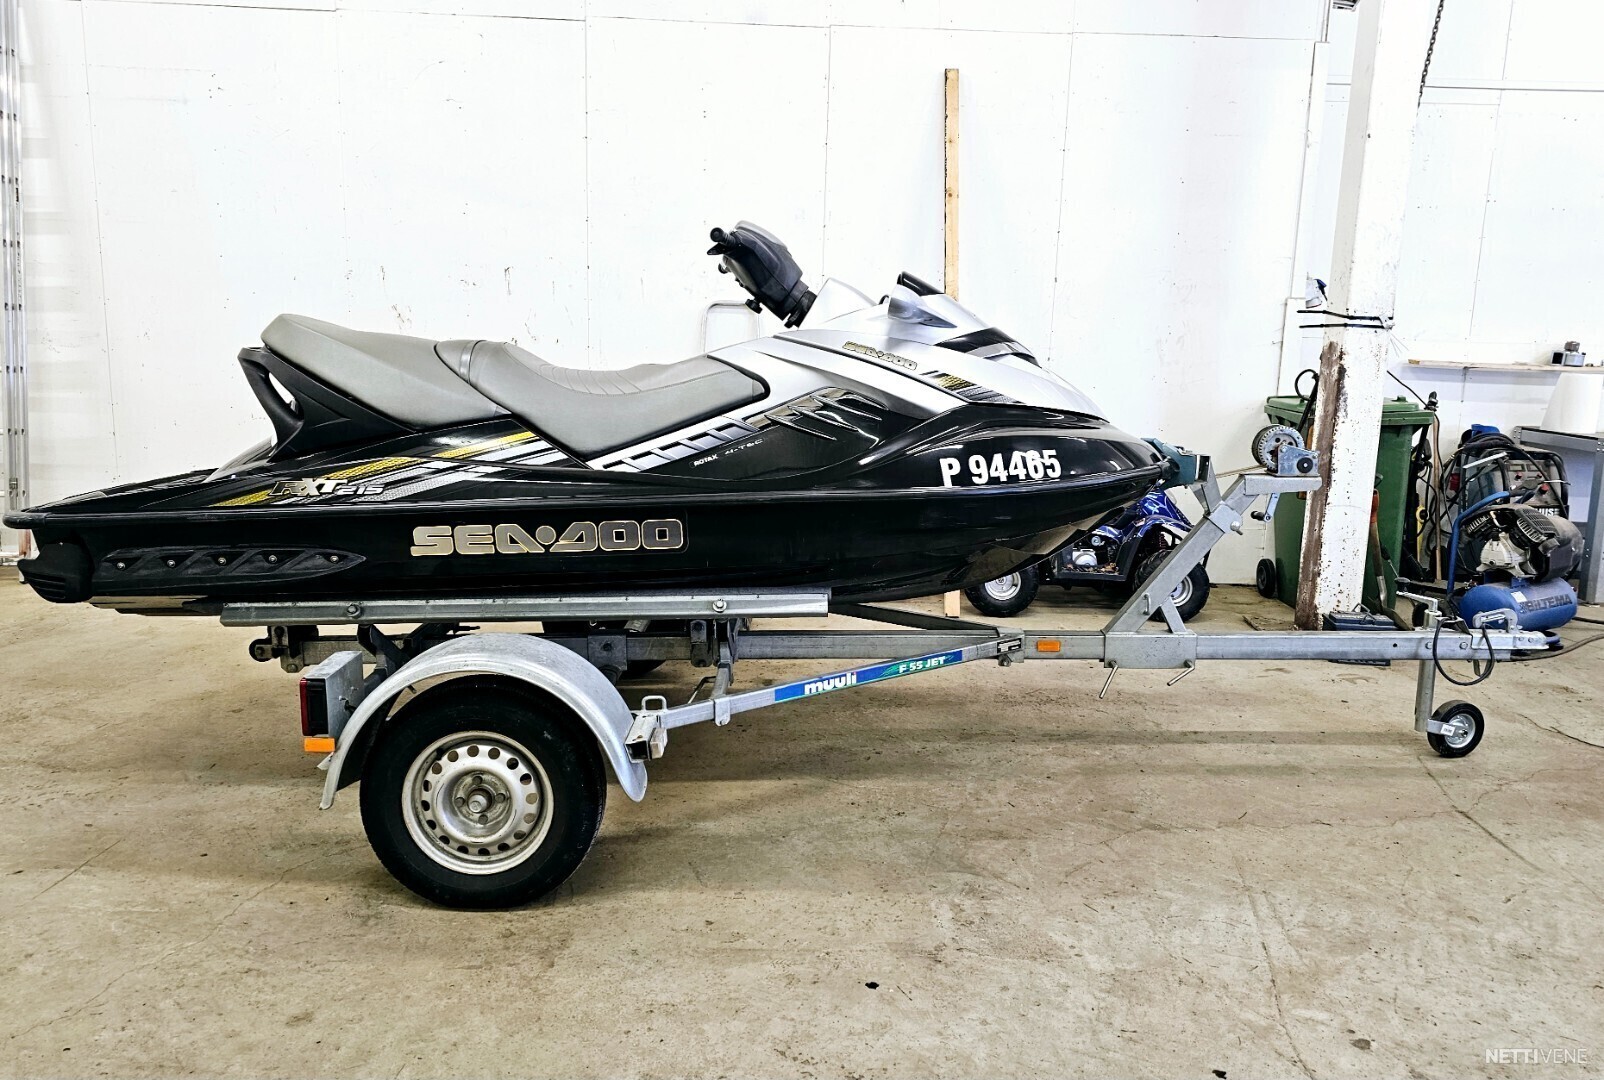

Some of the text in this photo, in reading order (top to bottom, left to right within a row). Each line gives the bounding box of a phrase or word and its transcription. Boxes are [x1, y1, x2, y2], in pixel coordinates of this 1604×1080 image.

[693, 453, 719, 467] ROTAX
[939, 449, 1062, 488] P 94465
[268, 477, 386, 497] RXT 215
[1526, 594, 1573, 612] BILTEMA
[899, 655, 947, 674] F 55 JET
[804, 671, 857, 695] muuli
